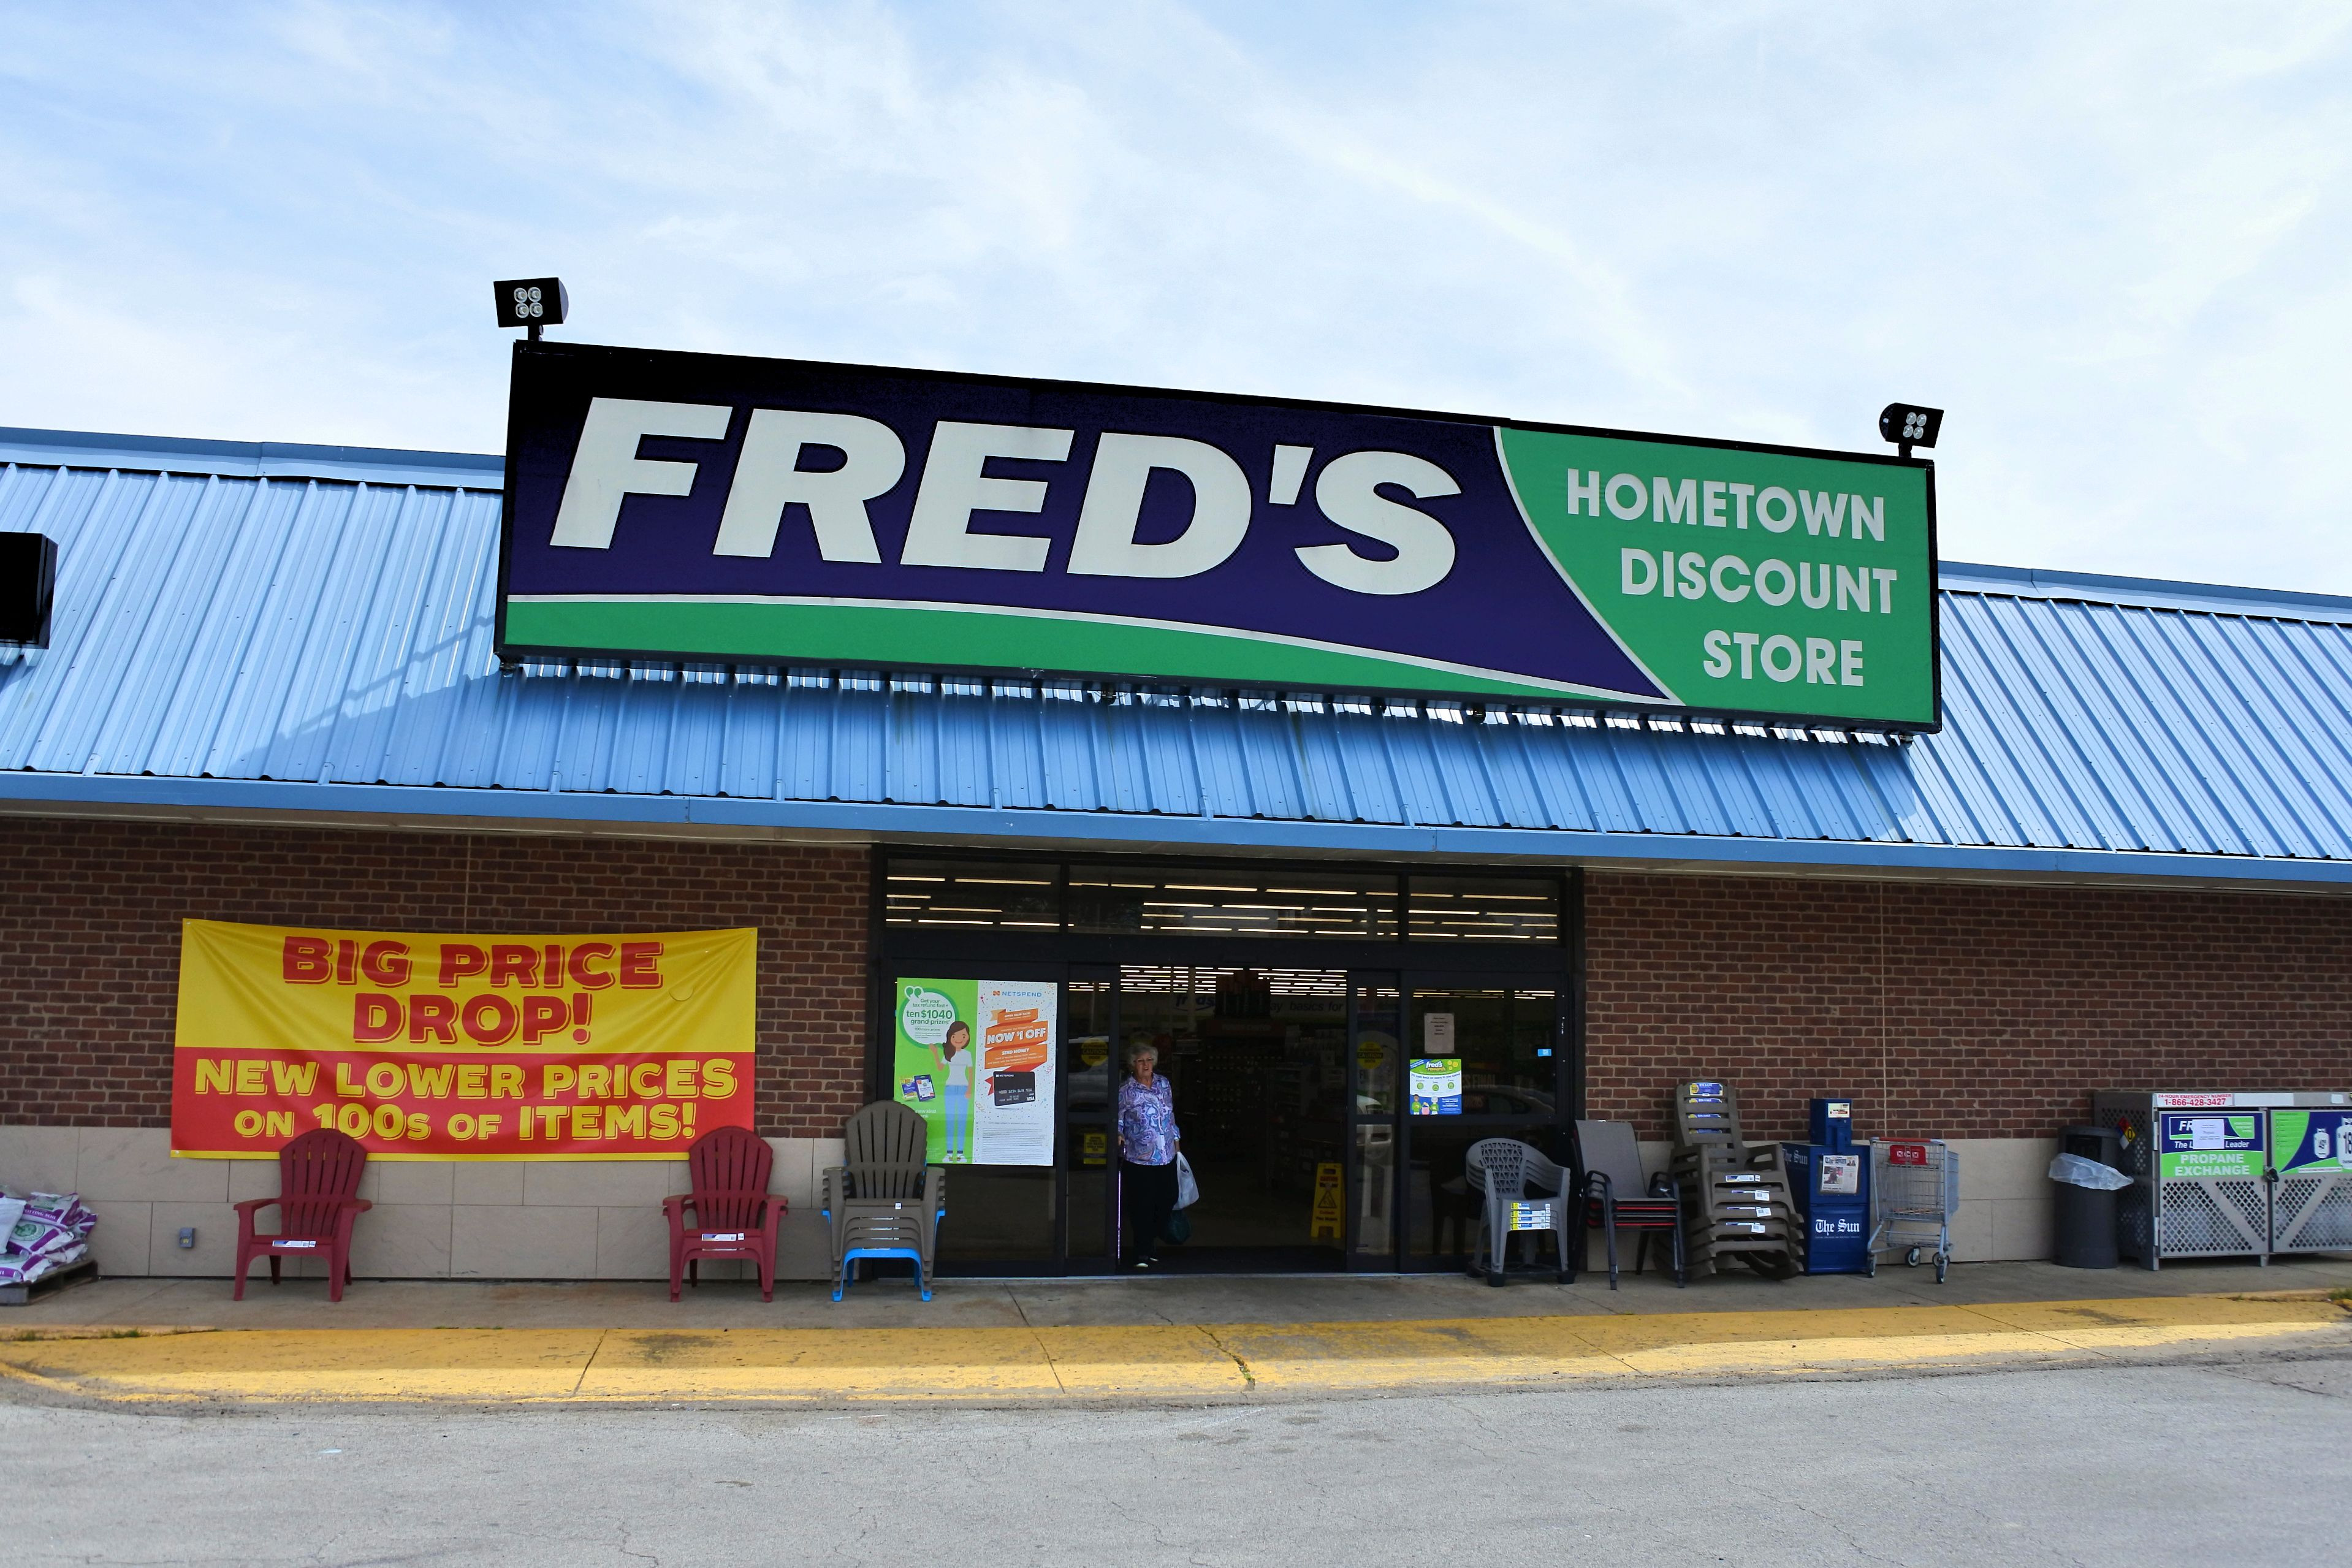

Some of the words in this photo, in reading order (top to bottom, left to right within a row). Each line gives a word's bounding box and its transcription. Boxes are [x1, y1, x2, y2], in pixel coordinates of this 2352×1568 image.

[550, 397, 1462, 595] FRED'S
[1567, 468, 1884, 541] HOMETOWN
[1621, 548, 1897, 614] DISCOUNT
[1703, 630, 1863, 687] STORE
[283, 935, 414, 988] BIG
[439, 942, 663, 991] PRICE
[353, 992, 593, 1046] DROP!
[921, 1009, 953, 1019] $1040
[1290, 1000, 1323, 1011] basics
[1328, 1001, 1344, 1011] for
[987, 1032, 1015, 1045] NOW
[1026, 1027, 1046, 1039] OFF
[195, 1059, 319, 1096] NEW
[336, 1062, 525, 1099] LOWER
[543, 1059, 738, 1100] PRICES
[234, 1110, 295, 1137] ON
[447, 1113, 502, 1141] OF
[519, 1102, 696, 1141] ITEMS!
[1794, 1149, 1808, 1165] Sun
[2174, 1165, 2250, 1176] EXCHANGE
[2180, 1153, 2245, 1164] PROPANE
[1815, 1219, 1835, 1236] The
[1837, 1219, 1860, 1233] Sun
